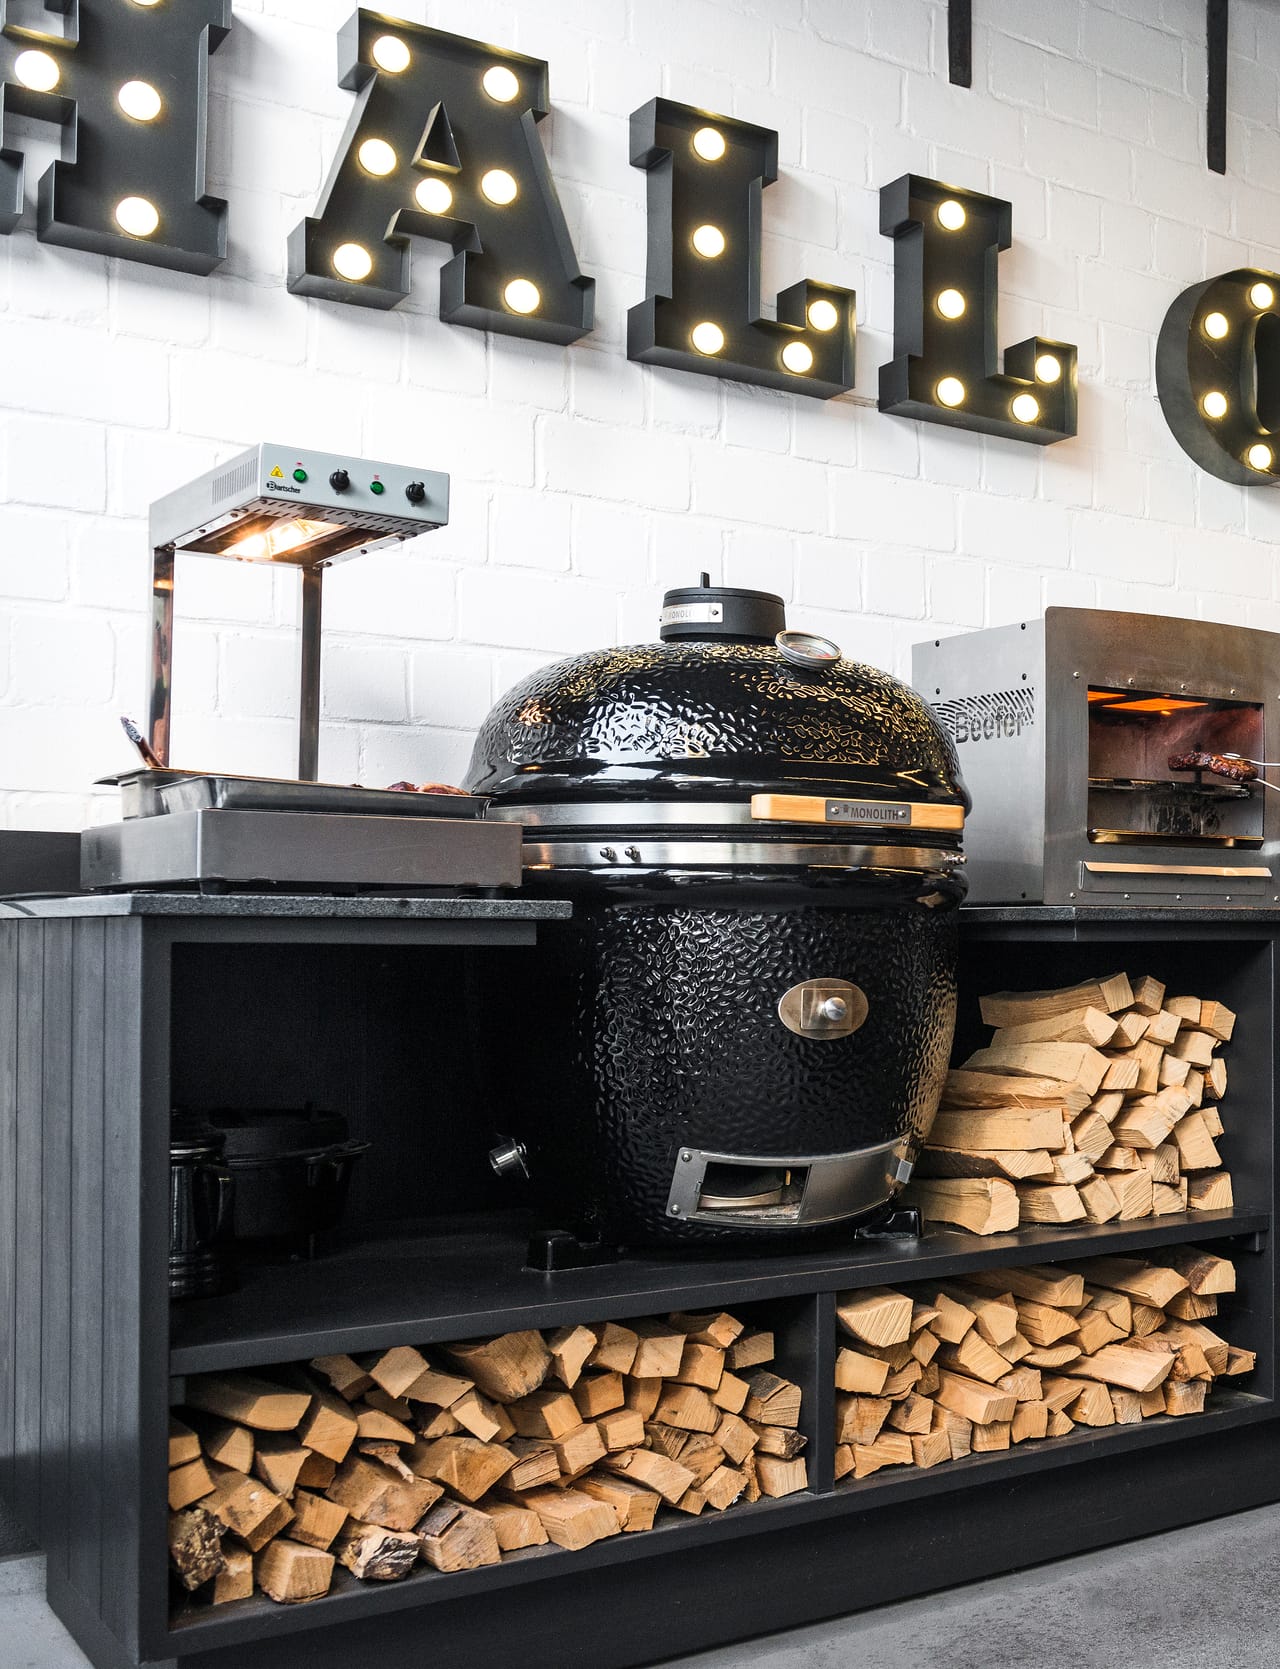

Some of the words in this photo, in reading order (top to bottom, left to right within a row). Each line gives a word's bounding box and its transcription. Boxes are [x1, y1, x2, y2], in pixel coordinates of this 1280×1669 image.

[0, 0, 1078, 445] HALL
[955, 705, 1025, 744] Beefer
[850, 807, 899, 820] MONOLITH
